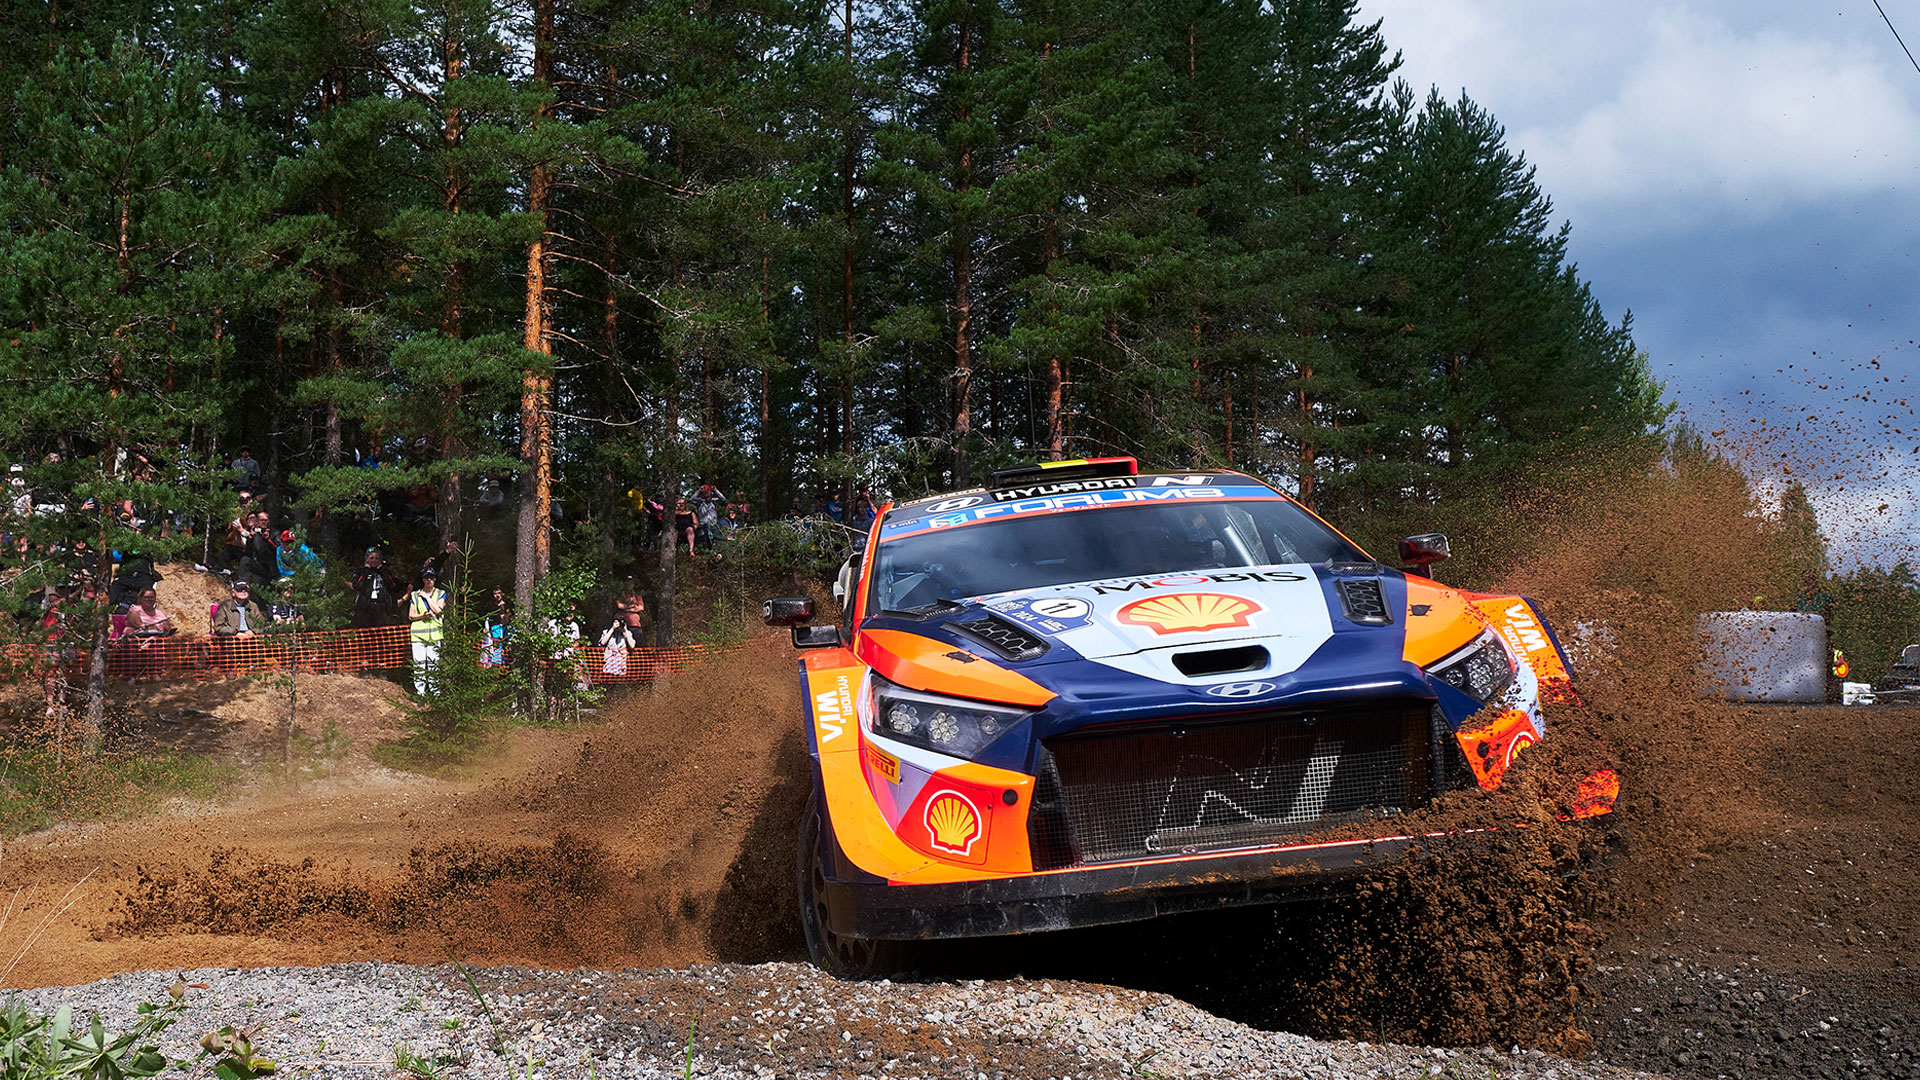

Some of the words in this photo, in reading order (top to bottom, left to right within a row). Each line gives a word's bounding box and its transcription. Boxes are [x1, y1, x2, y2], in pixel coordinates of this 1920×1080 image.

[973, 488, 1225, 519] FORUM8
[994, 478, 1137, 501] HYUNDAI
[1092, 571, 1307, 596] MOBIS
[1041, 602, 1076, 614] 11
[1502, 625, 1533, 668] YUNDAI
[837, 675, 854, 716] HYUNDAI
